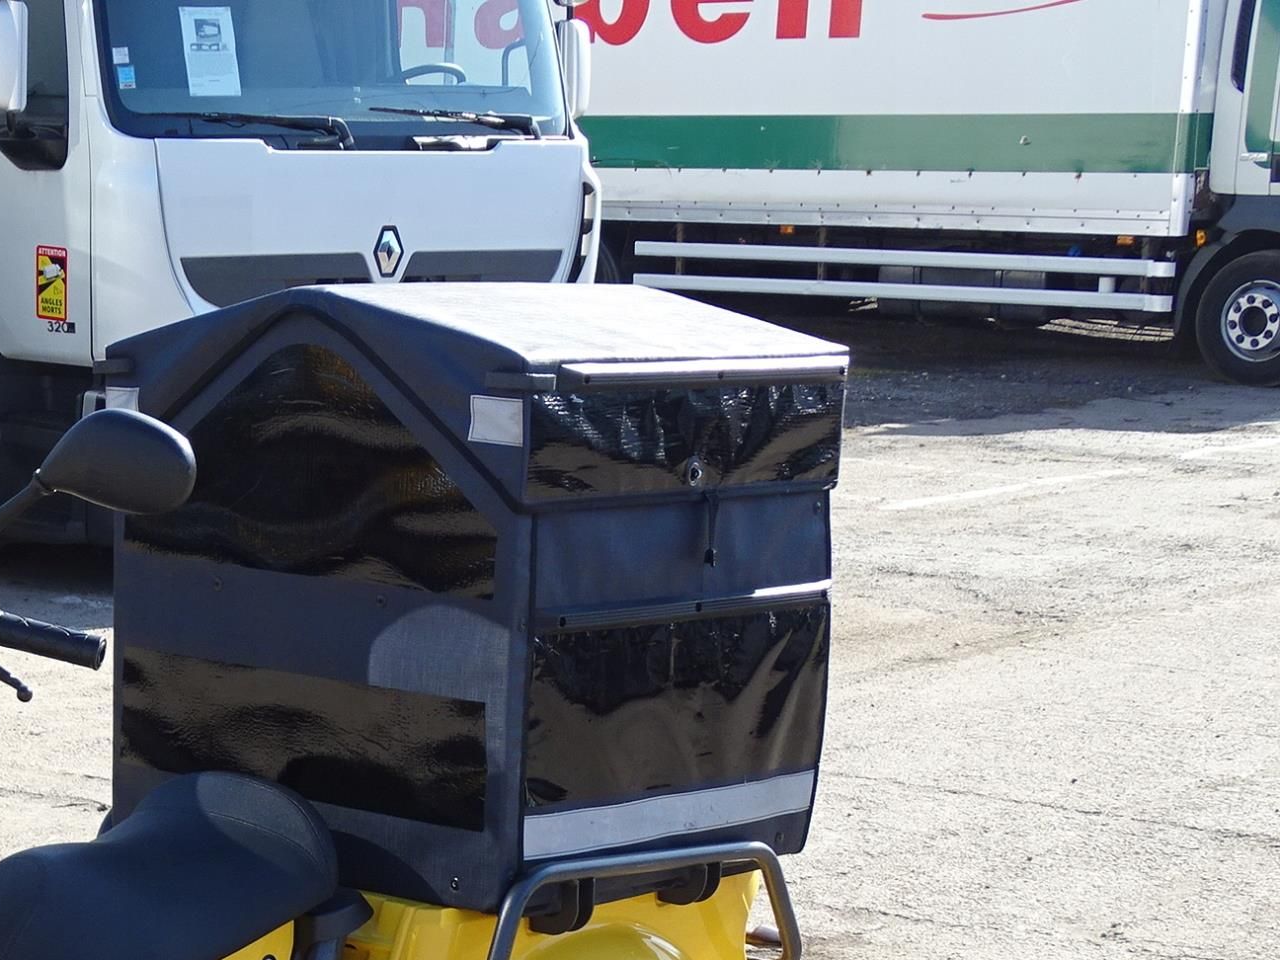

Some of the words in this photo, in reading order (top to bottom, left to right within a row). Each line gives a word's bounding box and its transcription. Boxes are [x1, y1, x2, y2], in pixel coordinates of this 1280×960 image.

[41, 297, 63, 307] ANGLES
[41, 305, 62, 315] MORTS
[48, 321, 68, 334] 320
